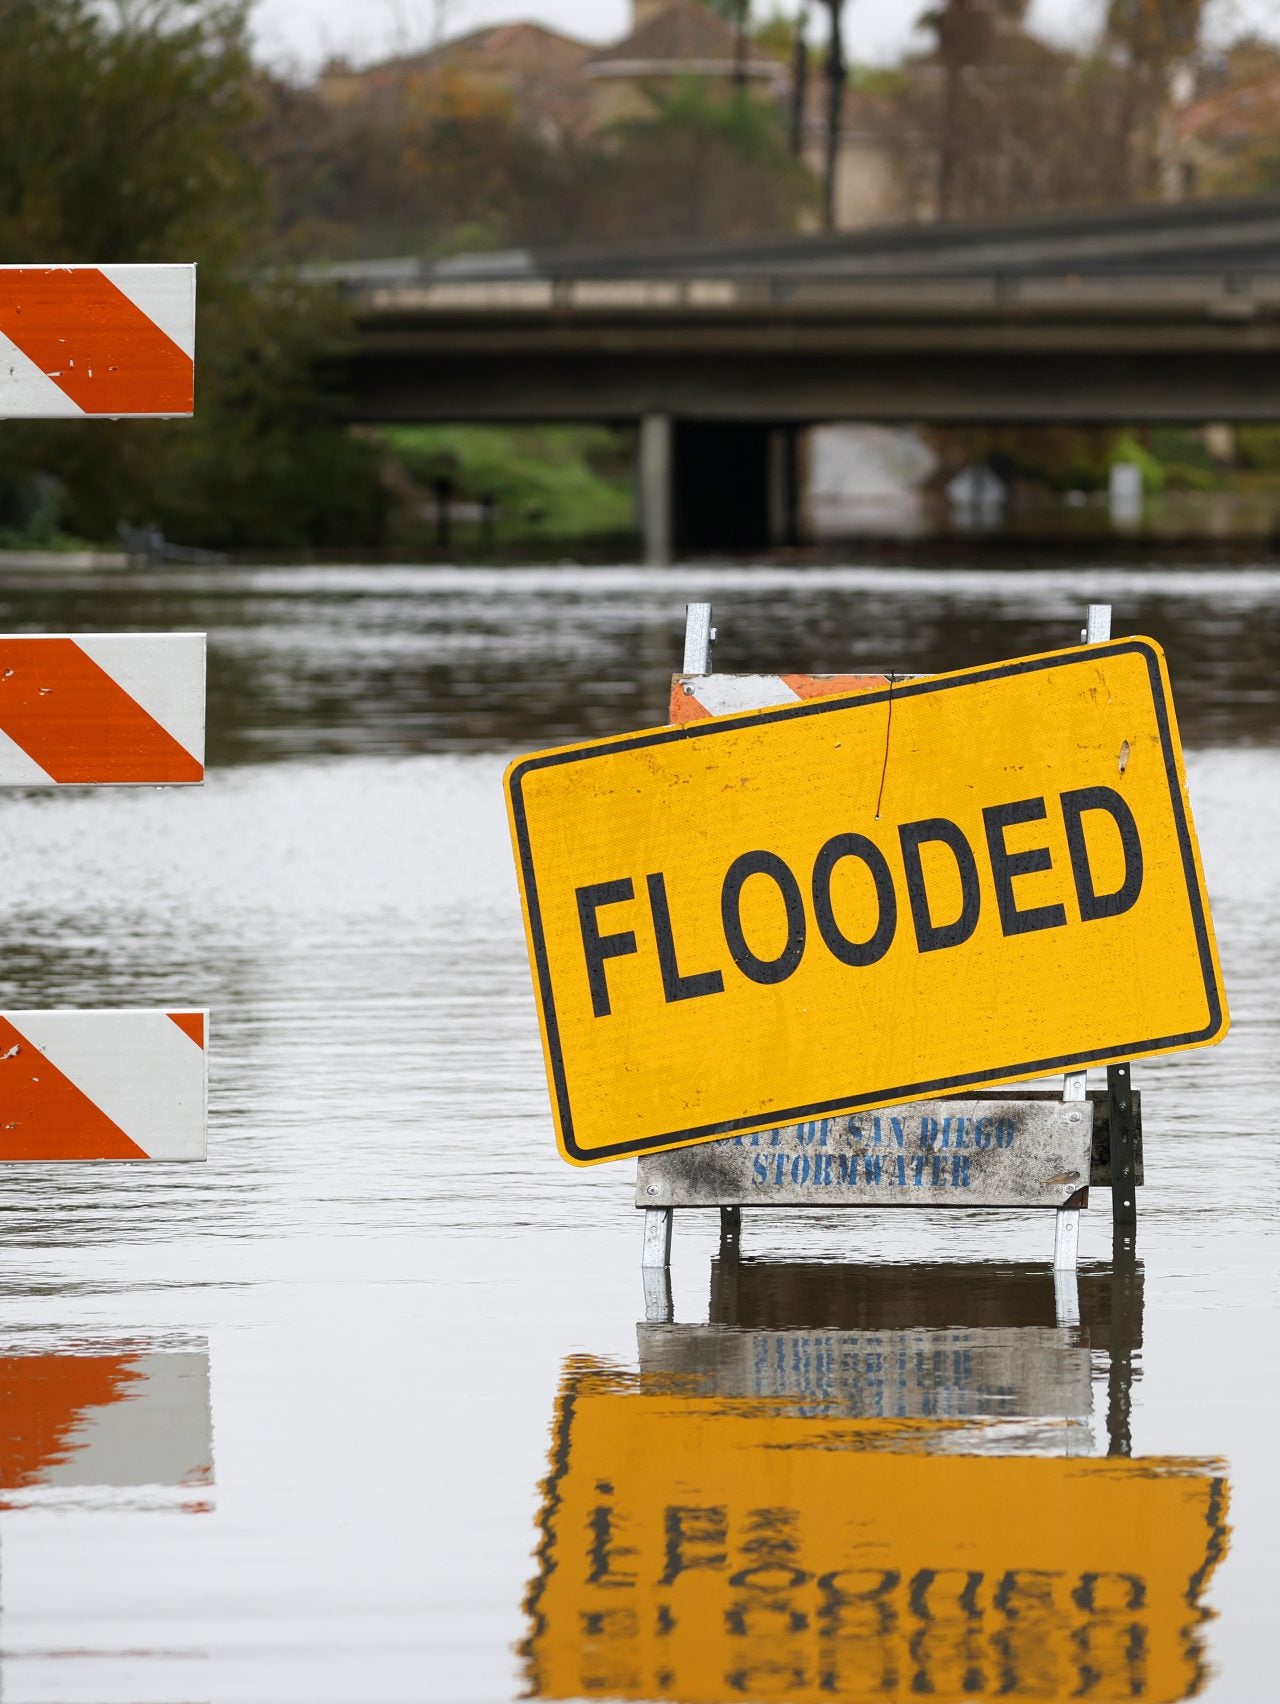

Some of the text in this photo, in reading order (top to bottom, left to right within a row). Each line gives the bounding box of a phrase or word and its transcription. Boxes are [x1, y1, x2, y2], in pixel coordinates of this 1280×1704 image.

[575, 785, 1144, 1018] FLOODED
[797, 1117, 836, 1147] OF
[848, 1116, 907, 1148] SAN
[920, 1116, 1015, 1149] DIEGO
[752, 1152, 972, 1187] STORMWATER
